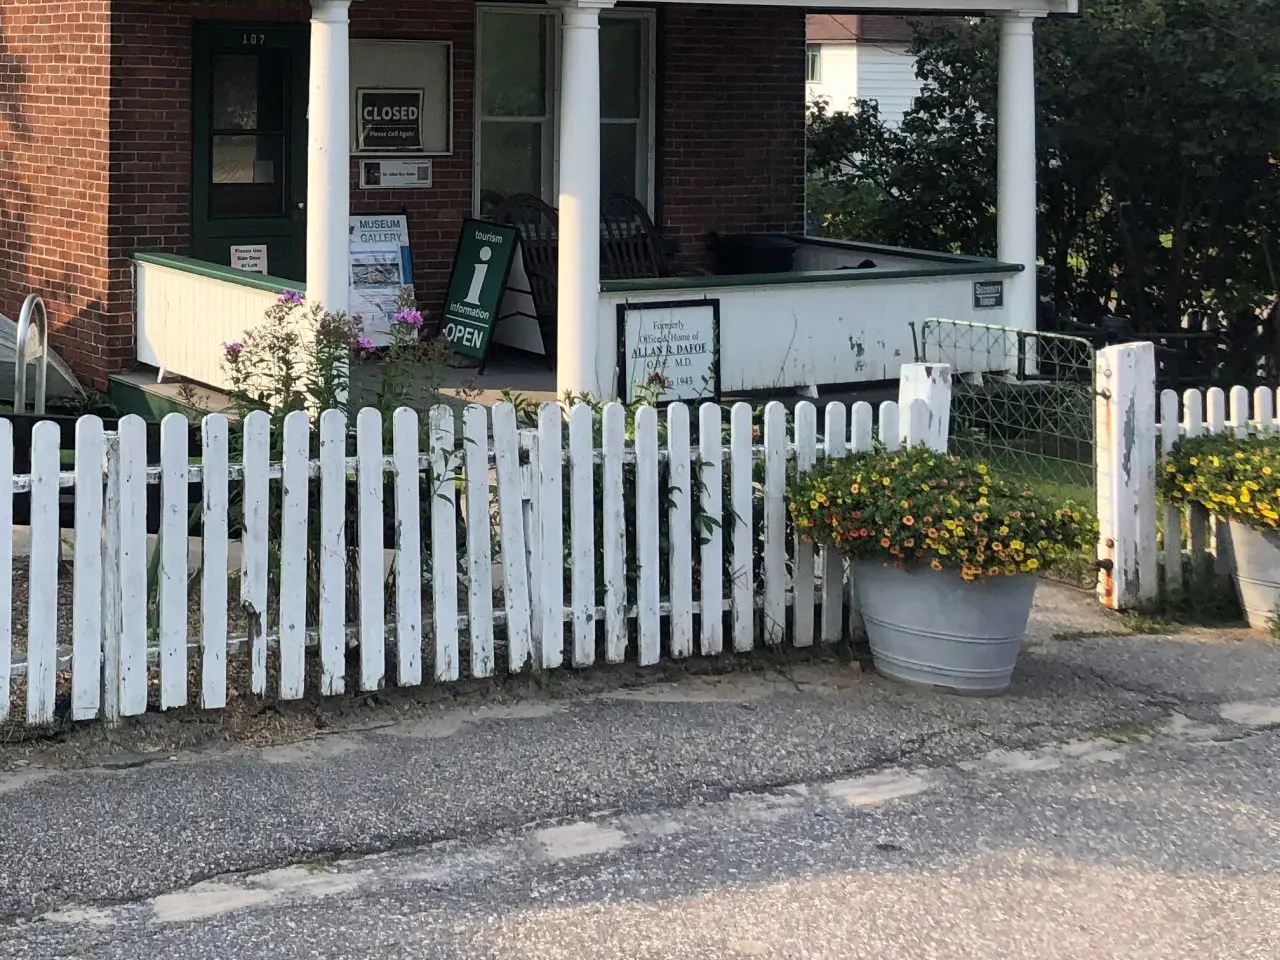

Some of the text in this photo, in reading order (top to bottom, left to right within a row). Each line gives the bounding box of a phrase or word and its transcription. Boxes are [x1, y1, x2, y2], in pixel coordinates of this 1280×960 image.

[242, 34, 265, 46] 107
[363, 106, 418, 120] CLOSED
[360, 219, 401, 229] MUSEUM
[360, 233, 402, 243] GALLERY
[475, 230, 503, 244] tourism
[450, 301, 490, 320] information
[653, 320, 684, 330] Formerly
[445, 322, 484, 349] OPEN
[639, 334, 662, 344] Office
[670, 333, 691, 342] Home
[691, 331, 699, 341] of
[632, 344, 663, 359] ALLAN
[676, 342, 707, 354] DAFOE
[676, 376, 693, 386] 1943
